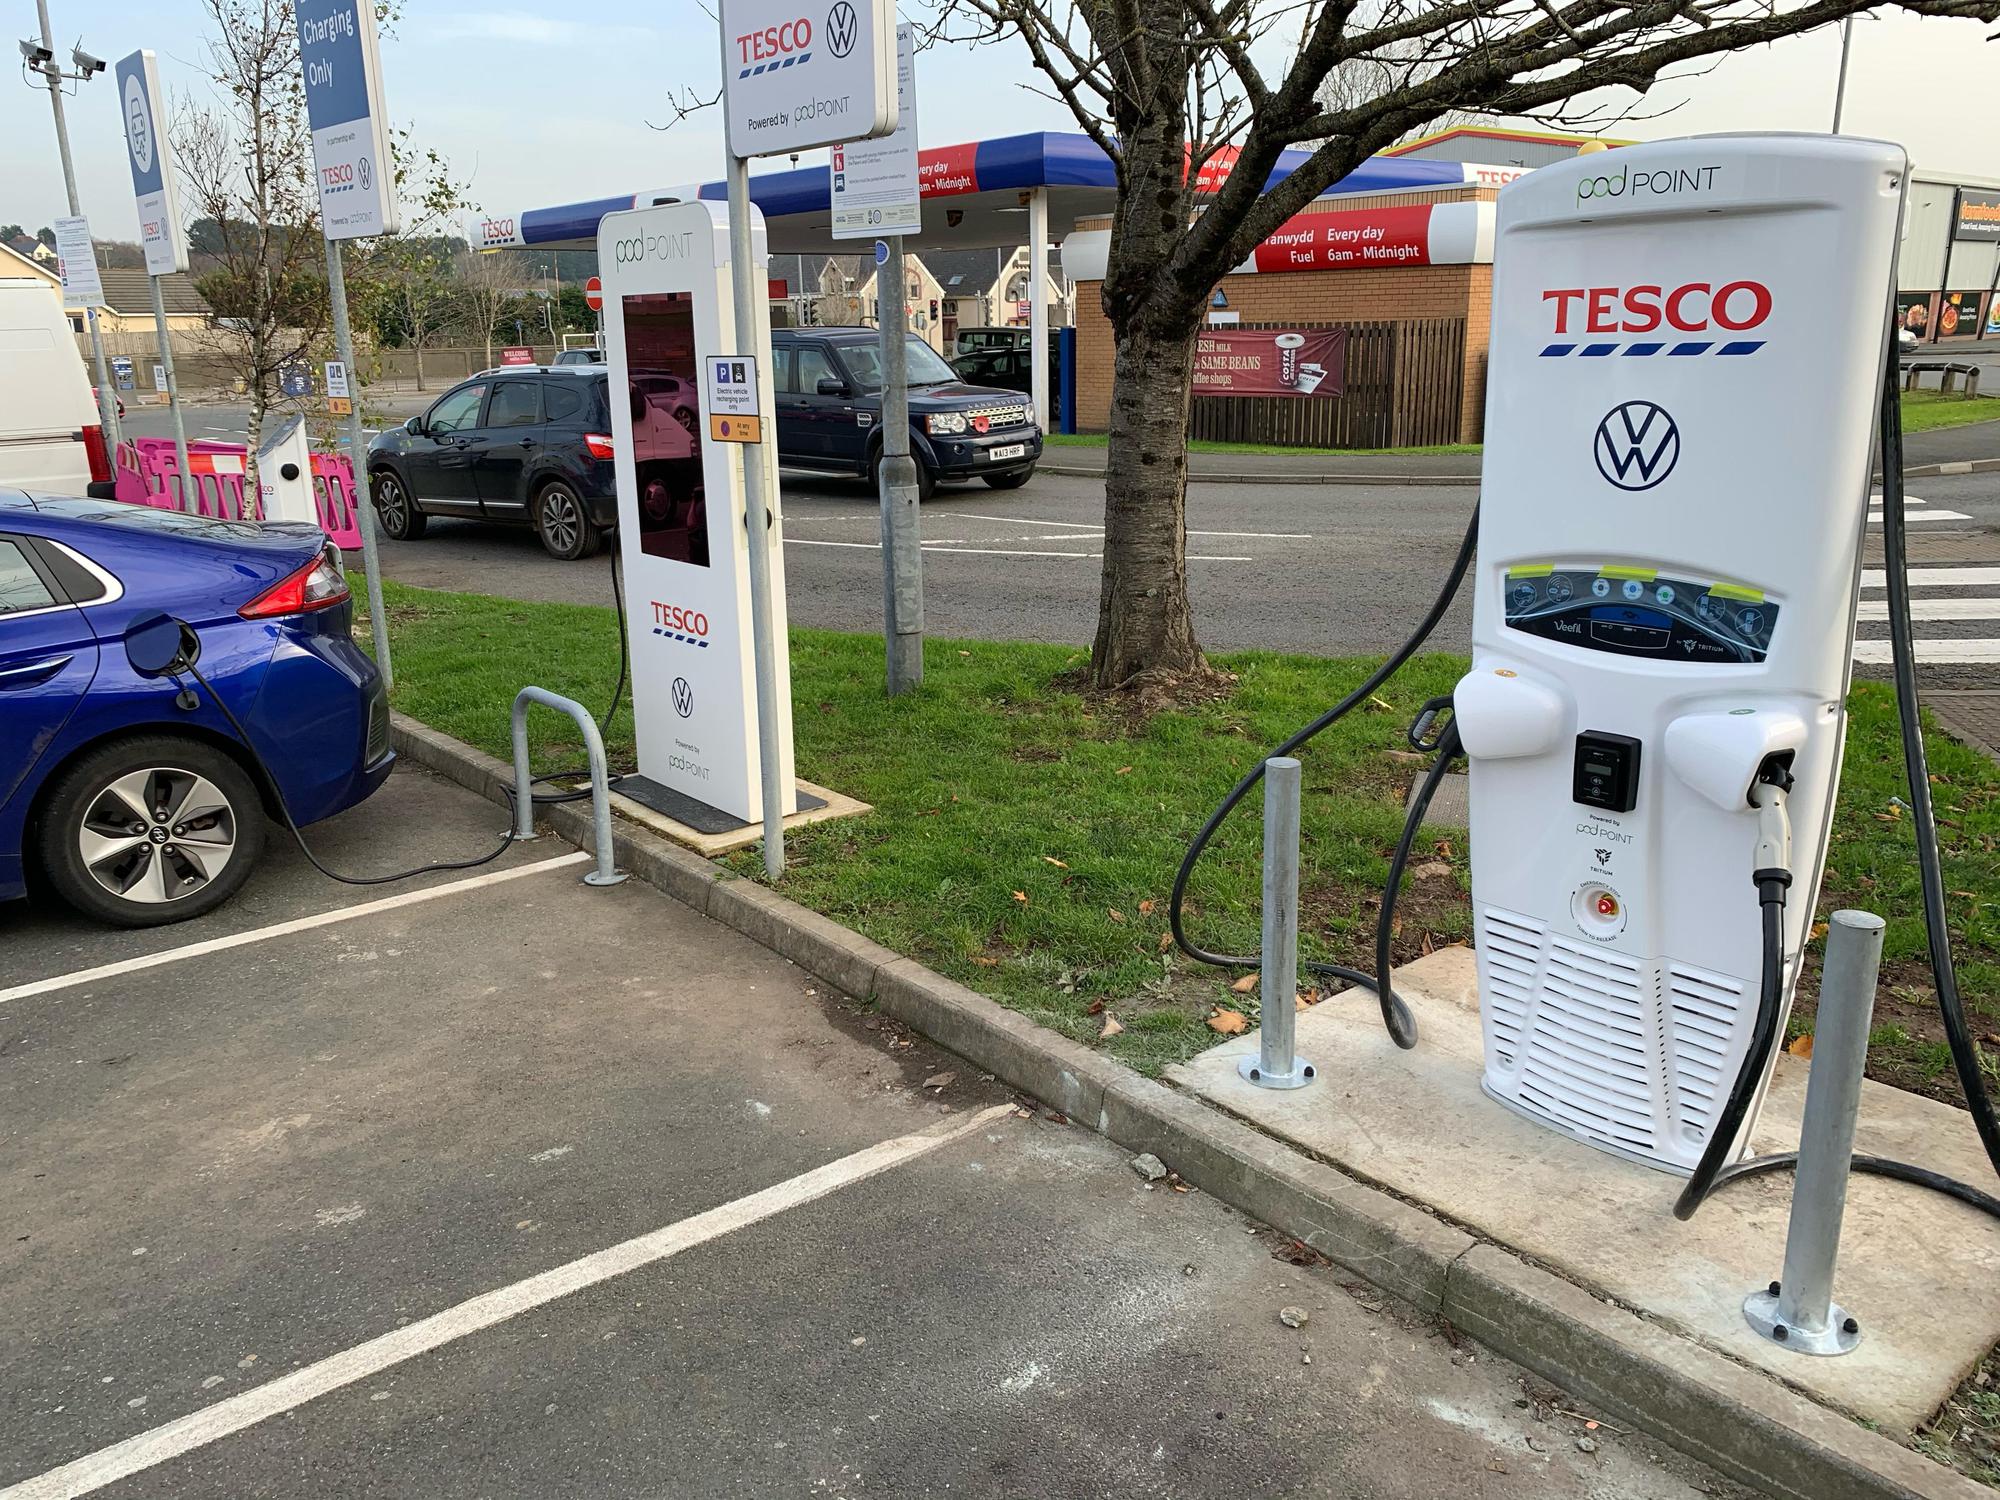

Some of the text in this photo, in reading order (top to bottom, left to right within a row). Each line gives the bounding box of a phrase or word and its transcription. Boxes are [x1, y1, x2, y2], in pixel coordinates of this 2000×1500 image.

[304, 8, 354, 45] Charging
[737, 18, 812, 64] TESCO
[309, 57, 333, 88] Only
[748, 96, 850, 131] Powered by pod POINT
[321, 164, 353, 186] TESCO
[934, 161, 948, 175] day
[920, 183, 931, 192] am
[935, 175, 971, 190] Midnight
[1477, 170, 1521, 184] TESC
[1577, 164, 1722, 208] pod POINT
[143, 221, 160, 236] TESCO
[481, 219, 514, 239] TESCO
[1328, 228, 1360, 243] Every
[1362, 225, 1385, 241] day
[616, 226, 693, 274] pod POINT
[1290, 249, 1315, 263] Fuel
[1327, 248, 1354, 261] 6am
[1363, 243, 1420, 261] Midnight
[1542, 280, 1773, 334] TESCO
[503, 350, 530, 358] WELCOME
[1197, 340, 1232, 353] ESH MILK
[1201, 356, 1228, 370] SAME
[1228, 356, 1261, 370] BEANS
[1283, 349, 1291, 381] COSTA
[1193, 372, 1232, 387] offee shops
[717, 387, 748, 395] Electric vehicle
[968, 398, 1021, 409] LAND ROVER
[993, 446, 1021, 459] WA13 HRF
[651, 601, 709, 637] TESCO
[1554, 619, 1582, 634] Veefil
[1698, 643, 1724, 653] TRITIUM
[675, 738, 700, 755] Powered by
[686, 760, 710, 781] POINT
[1589, 813, 1621, 827] Powered by
[1576, 823, 1634, 844] pod POINT
[1590, 866, 1613, 876] TRITIUM
[1580, 880, 1621, 898] EMERGENCY STOP
[1577, 924, 1588, 936] TURN
